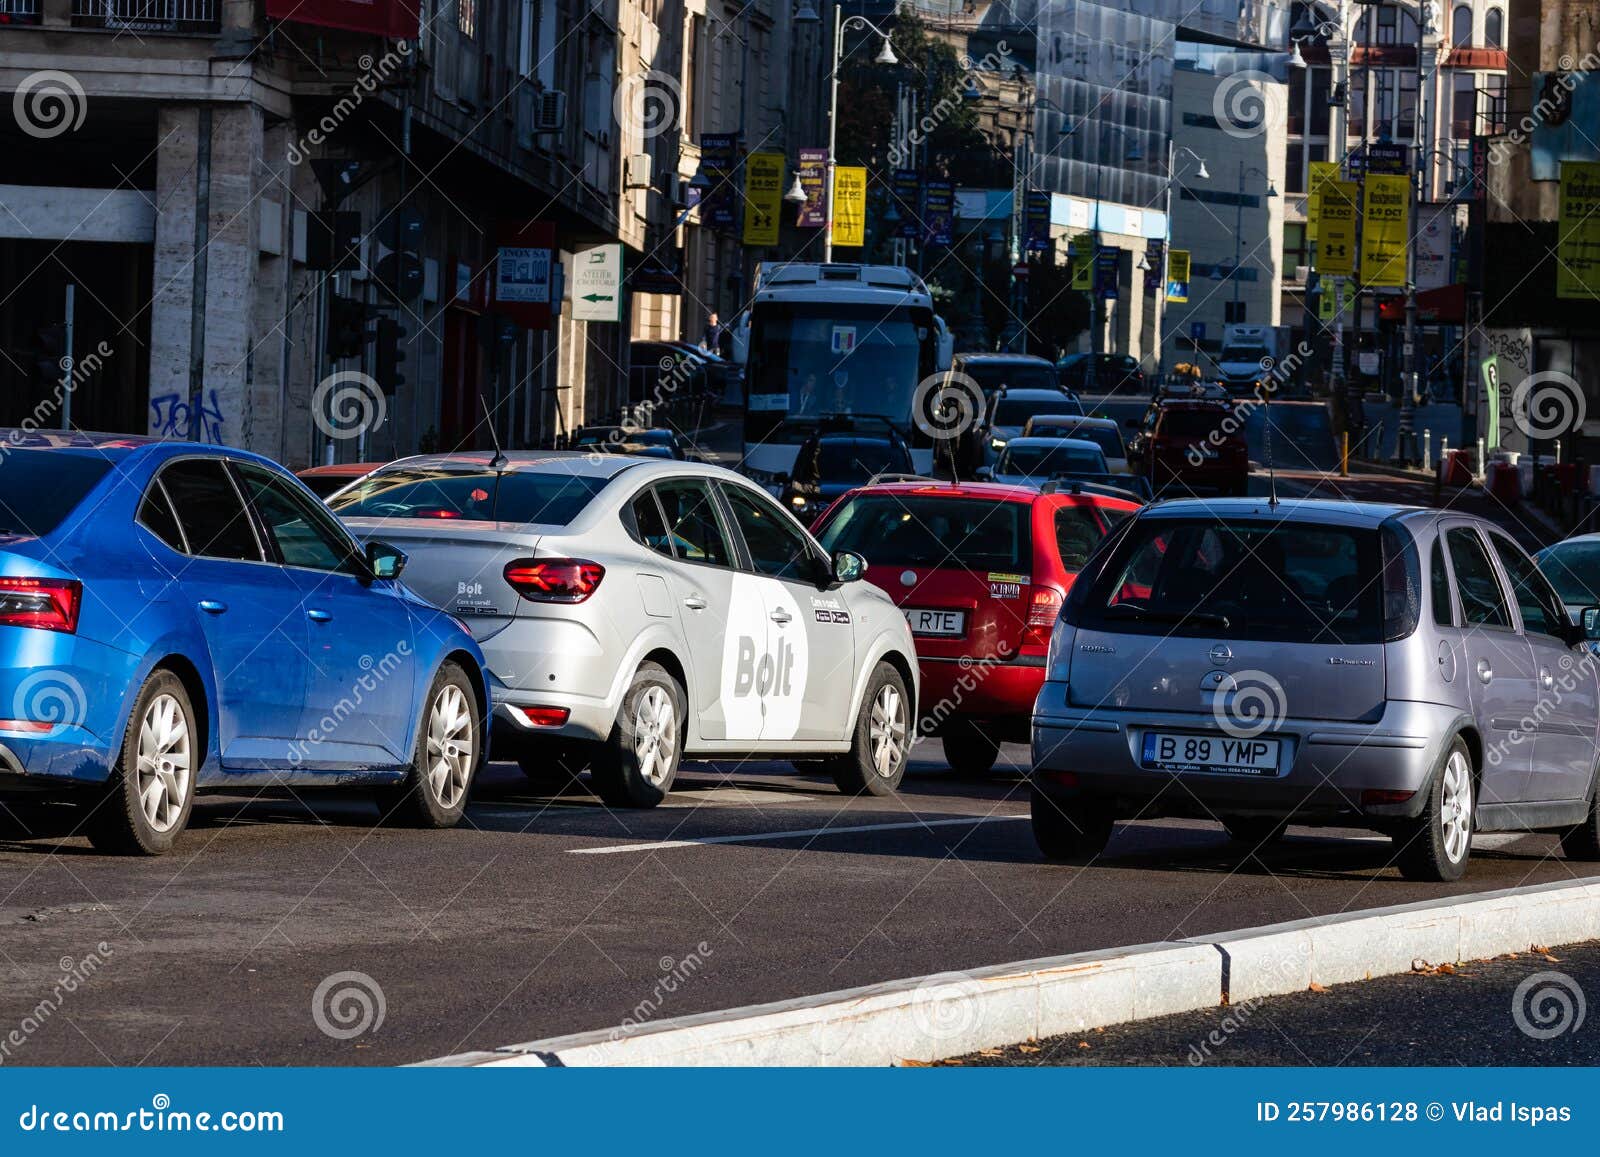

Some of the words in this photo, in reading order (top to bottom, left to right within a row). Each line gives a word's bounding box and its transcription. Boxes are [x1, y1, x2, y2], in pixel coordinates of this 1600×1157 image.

[458, 582, 482, 596] Bolt
[990, 583, 1020, 596] OCTAVIA
[920, 612, 956, 630] RTE
[734, 635, 794, 698] Bolt
[1144, 750, 1154, 759] RO
[1160, 738, 1176, 760] B
[1184, 739, 1211, 761] 89
[1222, 741, 1268, 764] YMP
